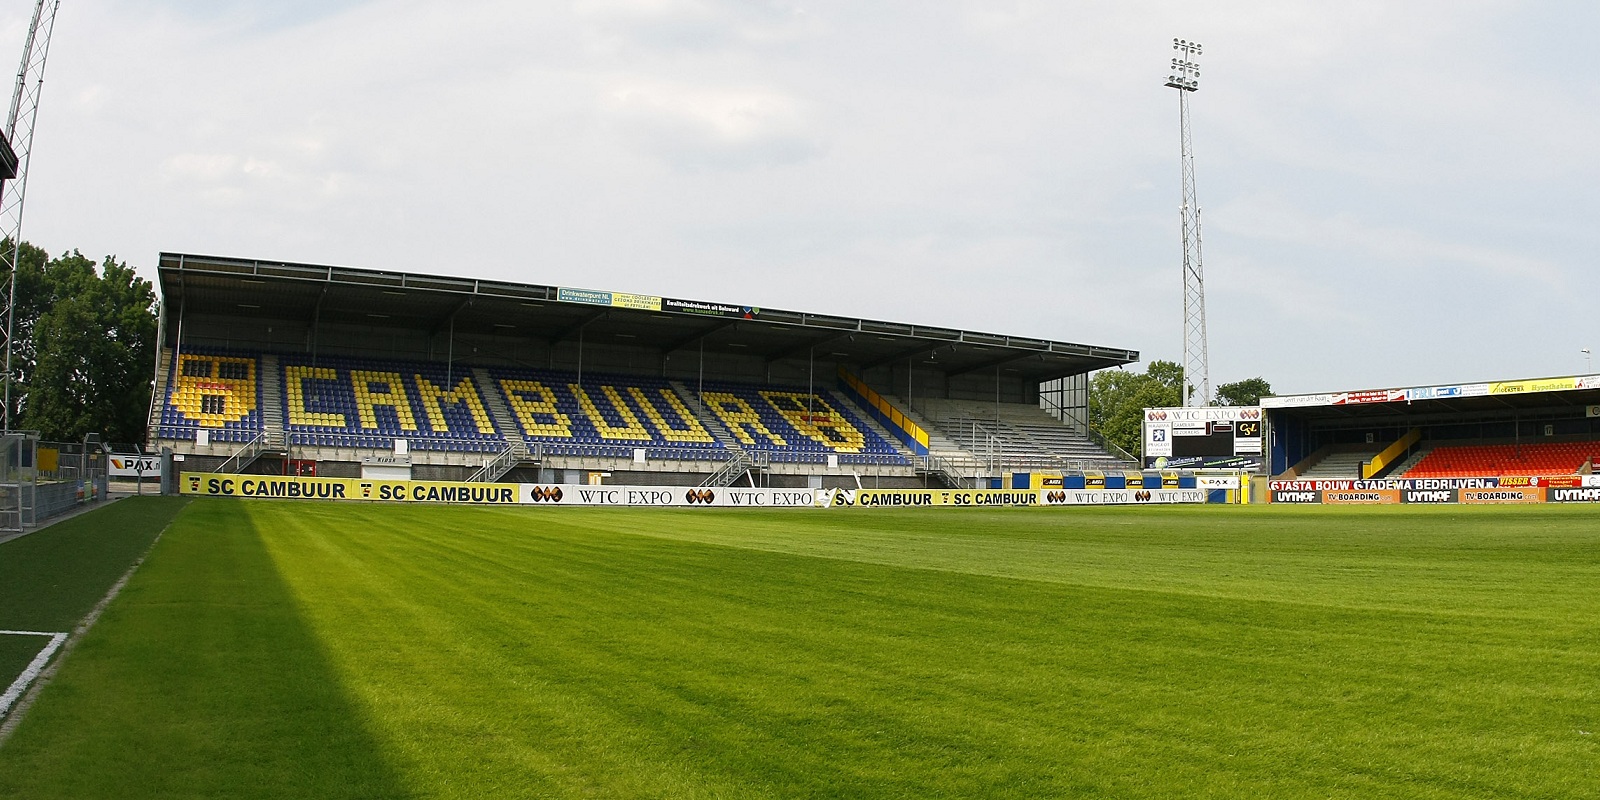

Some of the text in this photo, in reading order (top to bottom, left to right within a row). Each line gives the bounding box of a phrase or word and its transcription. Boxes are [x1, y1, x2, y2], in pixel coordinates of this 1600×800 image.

[561, 289, 601, 299] Drinkwaterpunt
[1531, 382, 1573, 392] Hypotheken
[285, 364, 788, 446] CAMBUUR
[1172, 410, 1236, 420] WTC EXPO
[207, 478, 346, 498] SC CAMBUUR
[1315, 480, 1350, 491] BOUW
[1500, 477, 1529, 486] VISSER
[379, 484, 514, 503] SC CAMBUUR
[578, 489, 673, 505] WTC EXPO
[729, 492, 812, 505] WTC EXPO
[860, 493, 933, 506] CAMBUUR
[953, 492, 1037, 505] SC CAMBUUR
[1074, 491, 1128, 503] WTC EXPO
[1158, 490, 1204, 502] WTC EXPO
[1277, 491, 1316, 502] UYTHOF
[1407, 490, 1451, 503] UYTHOF
[1554, 488, 1600, 501] UYTHOF
